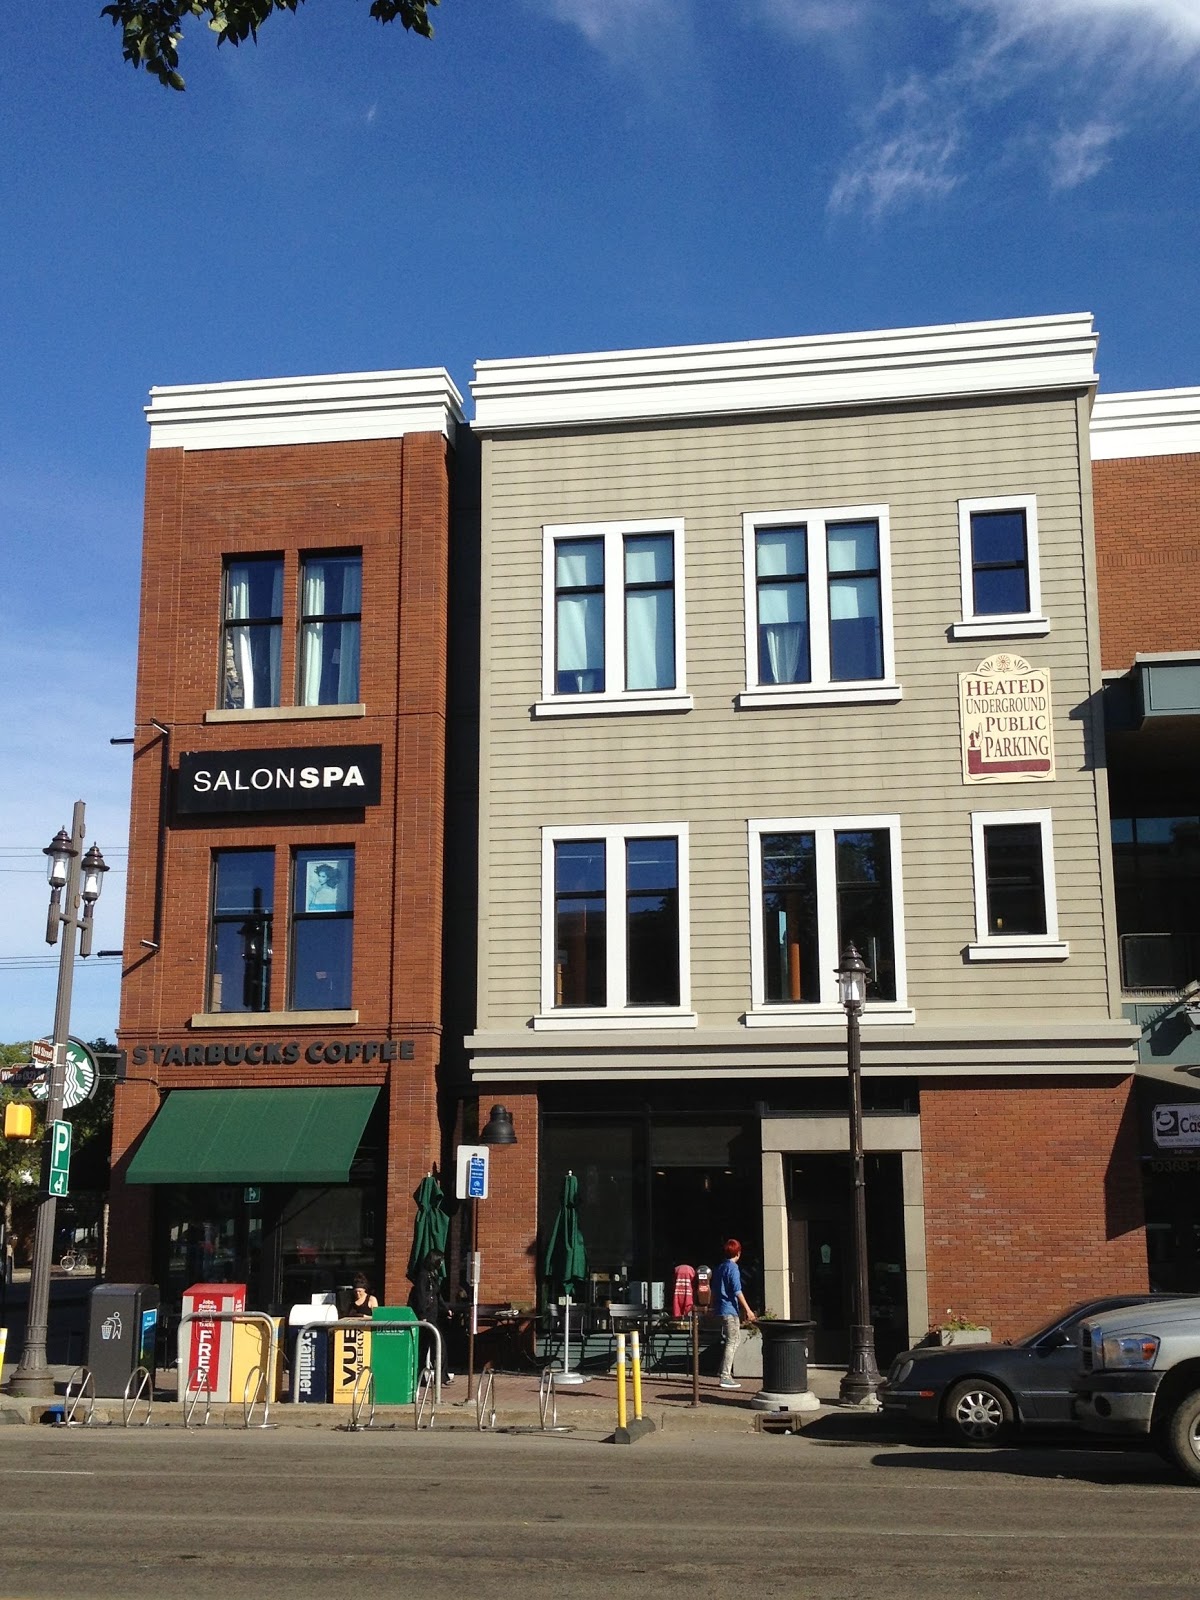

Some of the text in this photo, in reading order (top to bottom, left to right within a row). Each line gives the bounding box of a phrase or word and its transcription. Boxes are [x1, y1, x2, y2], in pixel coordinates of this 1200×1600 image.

[966, 679, 1044, 696] HEATED
[966, 697, 1046, 714] UNDERGROUND
[985, 716, 1047, 732] PUBLIC
[984, 735, 1049, 757] PARKING
[132, 1040, 415, 1066] STARBUCKS COFFEE
[54, 1125, 69, 1167] P
[197, 1330, 213, 1382] FREE
[300, 1328, 317, 1395] Examiner
[343, 1328, 357, 1386] VUE
